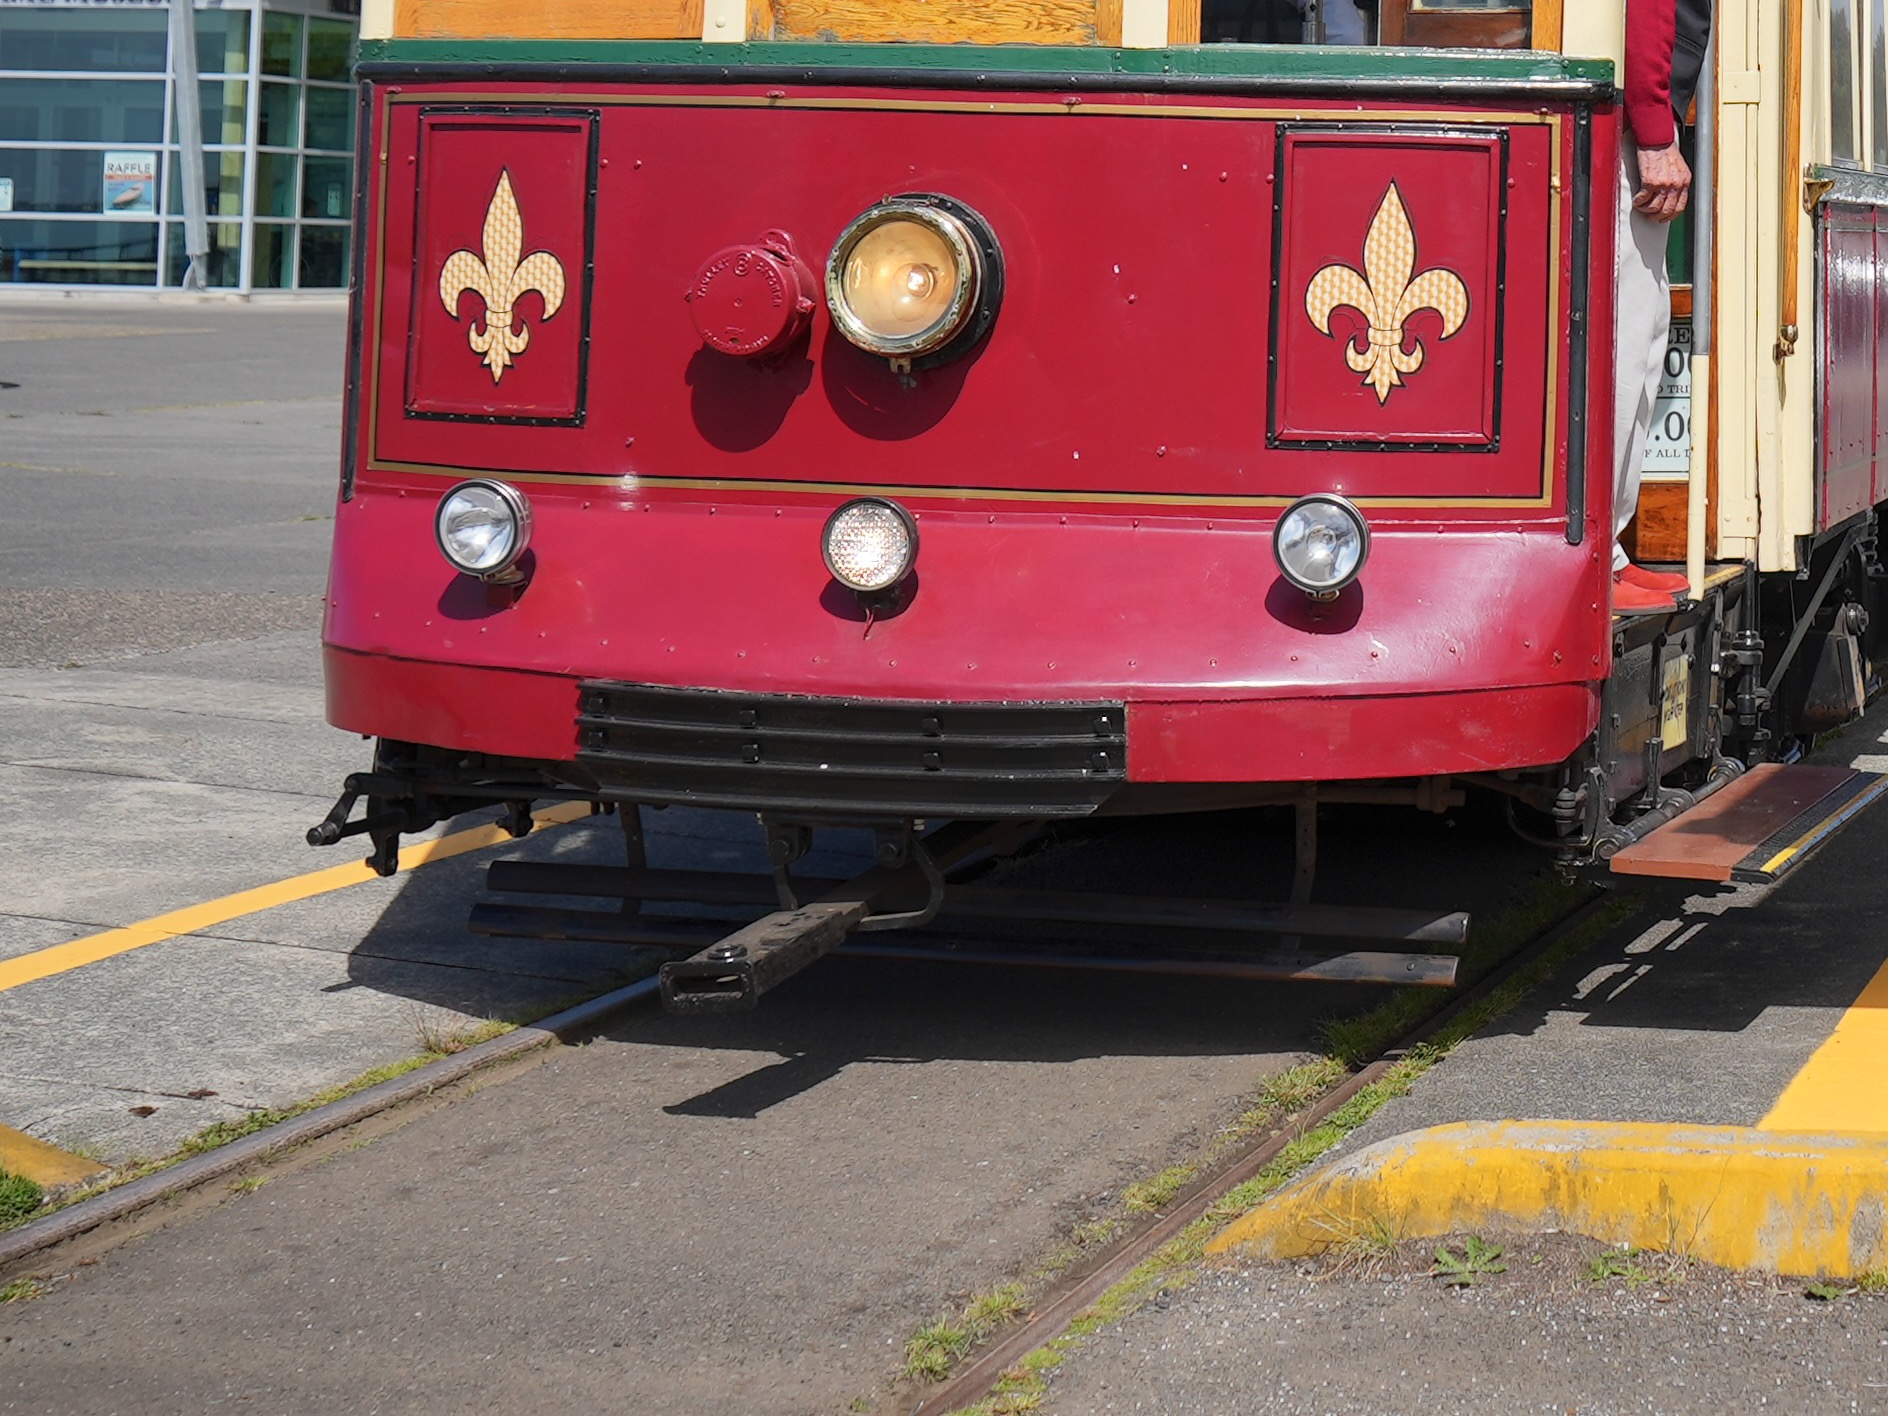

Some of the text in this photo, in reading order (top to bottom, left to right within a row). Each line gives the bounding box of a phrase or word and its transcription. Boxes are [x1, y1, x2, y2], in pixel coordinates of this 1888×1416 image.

[107, 163, 151, 174] RAFFLE
[1667, 385, 1689, 393] TRI
[1656, 449, 1680, 458] ALL
